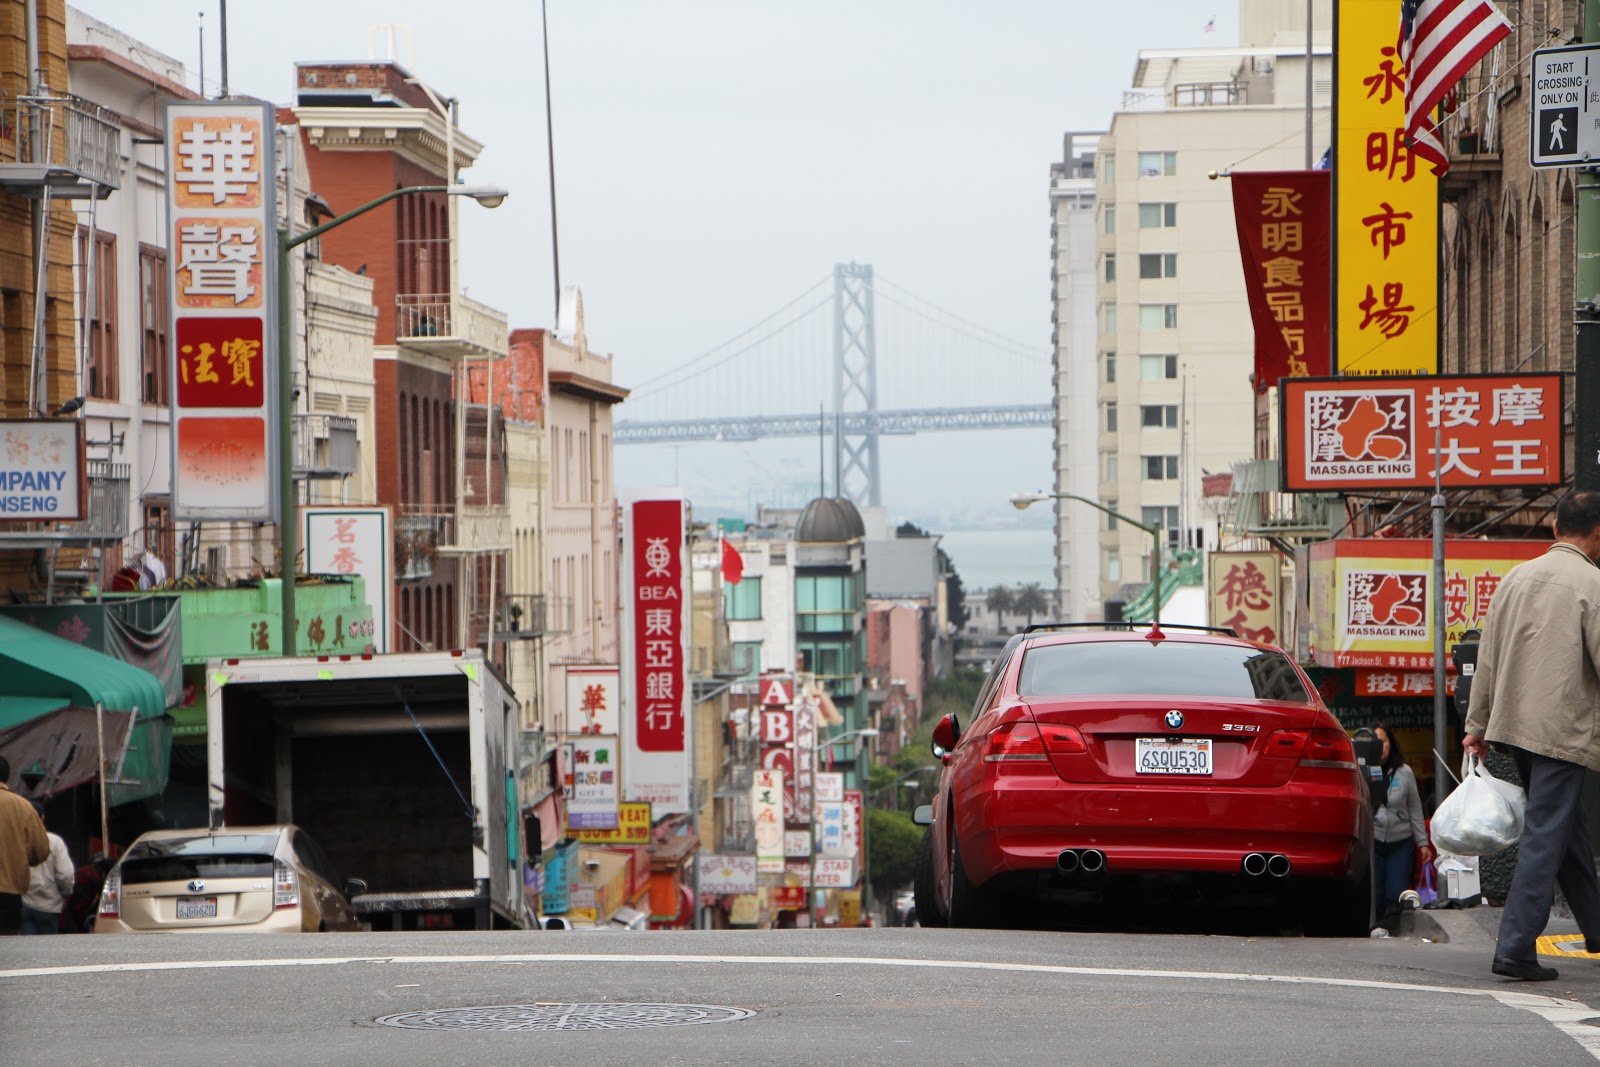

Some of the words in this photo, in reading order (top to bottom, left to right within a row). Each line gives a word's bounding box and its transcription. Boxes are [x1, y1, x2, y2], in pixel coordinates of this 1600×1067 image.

[1546, 62, 1574, 74] START
[1537, 76, 1583, 90] CROSSING
[1540, 93, 1563, 104] ONLY
[1565, 92, 1579, 103] ON
[1359, 46, 1415, 339] 永明市場
[1425, 384, 1545, 429] 按摩
[1427, 438, 1545, 480] 大王
[1310, 464, 1375, 475] MASSAGE
[1378, 463, 1412, 474] KING
[639, 586, 678, 600] BEA
[1347, 627, 1397, 636] MASSAGE
[1400, 627, 1426, 637] KING
[1337, 655, 1350, 665] 777
[1351, 656, 1374, 666] Jackson
[645, 608, 674, 730] 東亞銀行
[1141, 750, 1207, 768] 6SQU530
[627, 808, 647, 822] EAT
[823, 860, 850, 872] STAR
